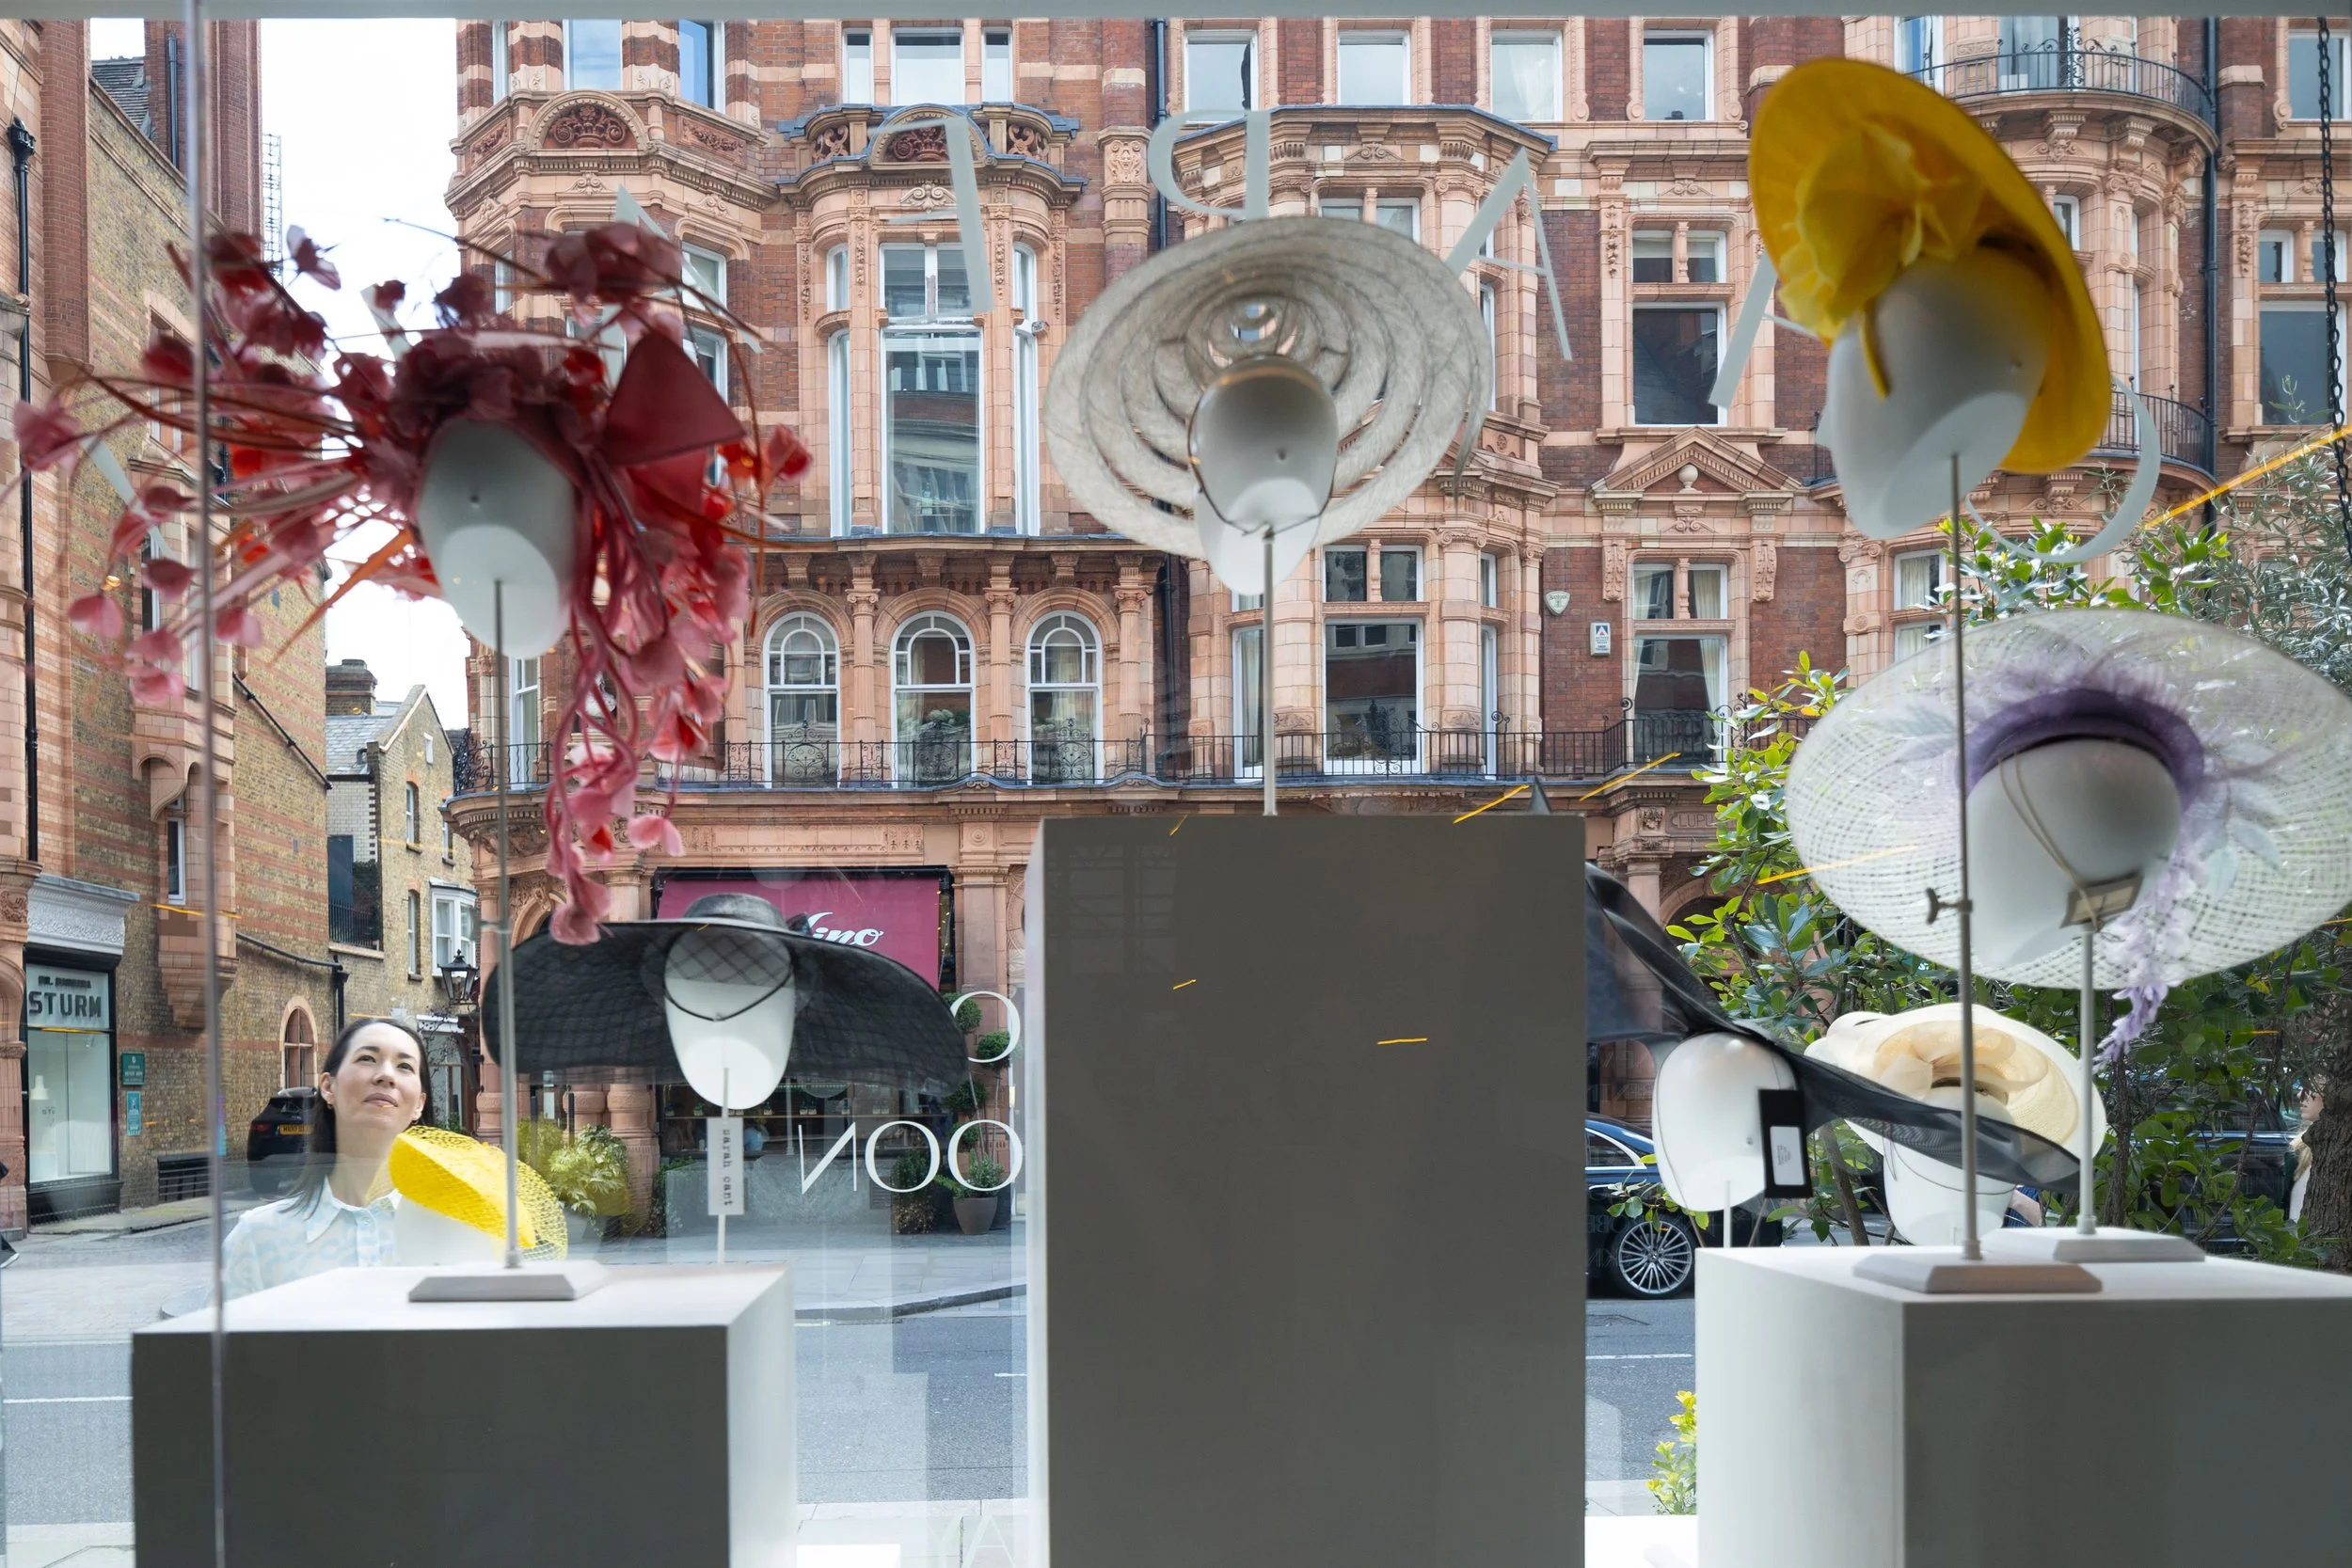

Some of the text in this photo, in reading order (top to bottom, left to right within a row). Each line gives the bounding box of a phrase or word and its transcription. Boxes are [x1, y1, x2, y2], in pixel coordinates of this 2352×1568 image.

[1679, 814, 1714, 828] LUPU
[28, 990, 102, 1018] STURM
[723, 1176, 733, 1206] cant
